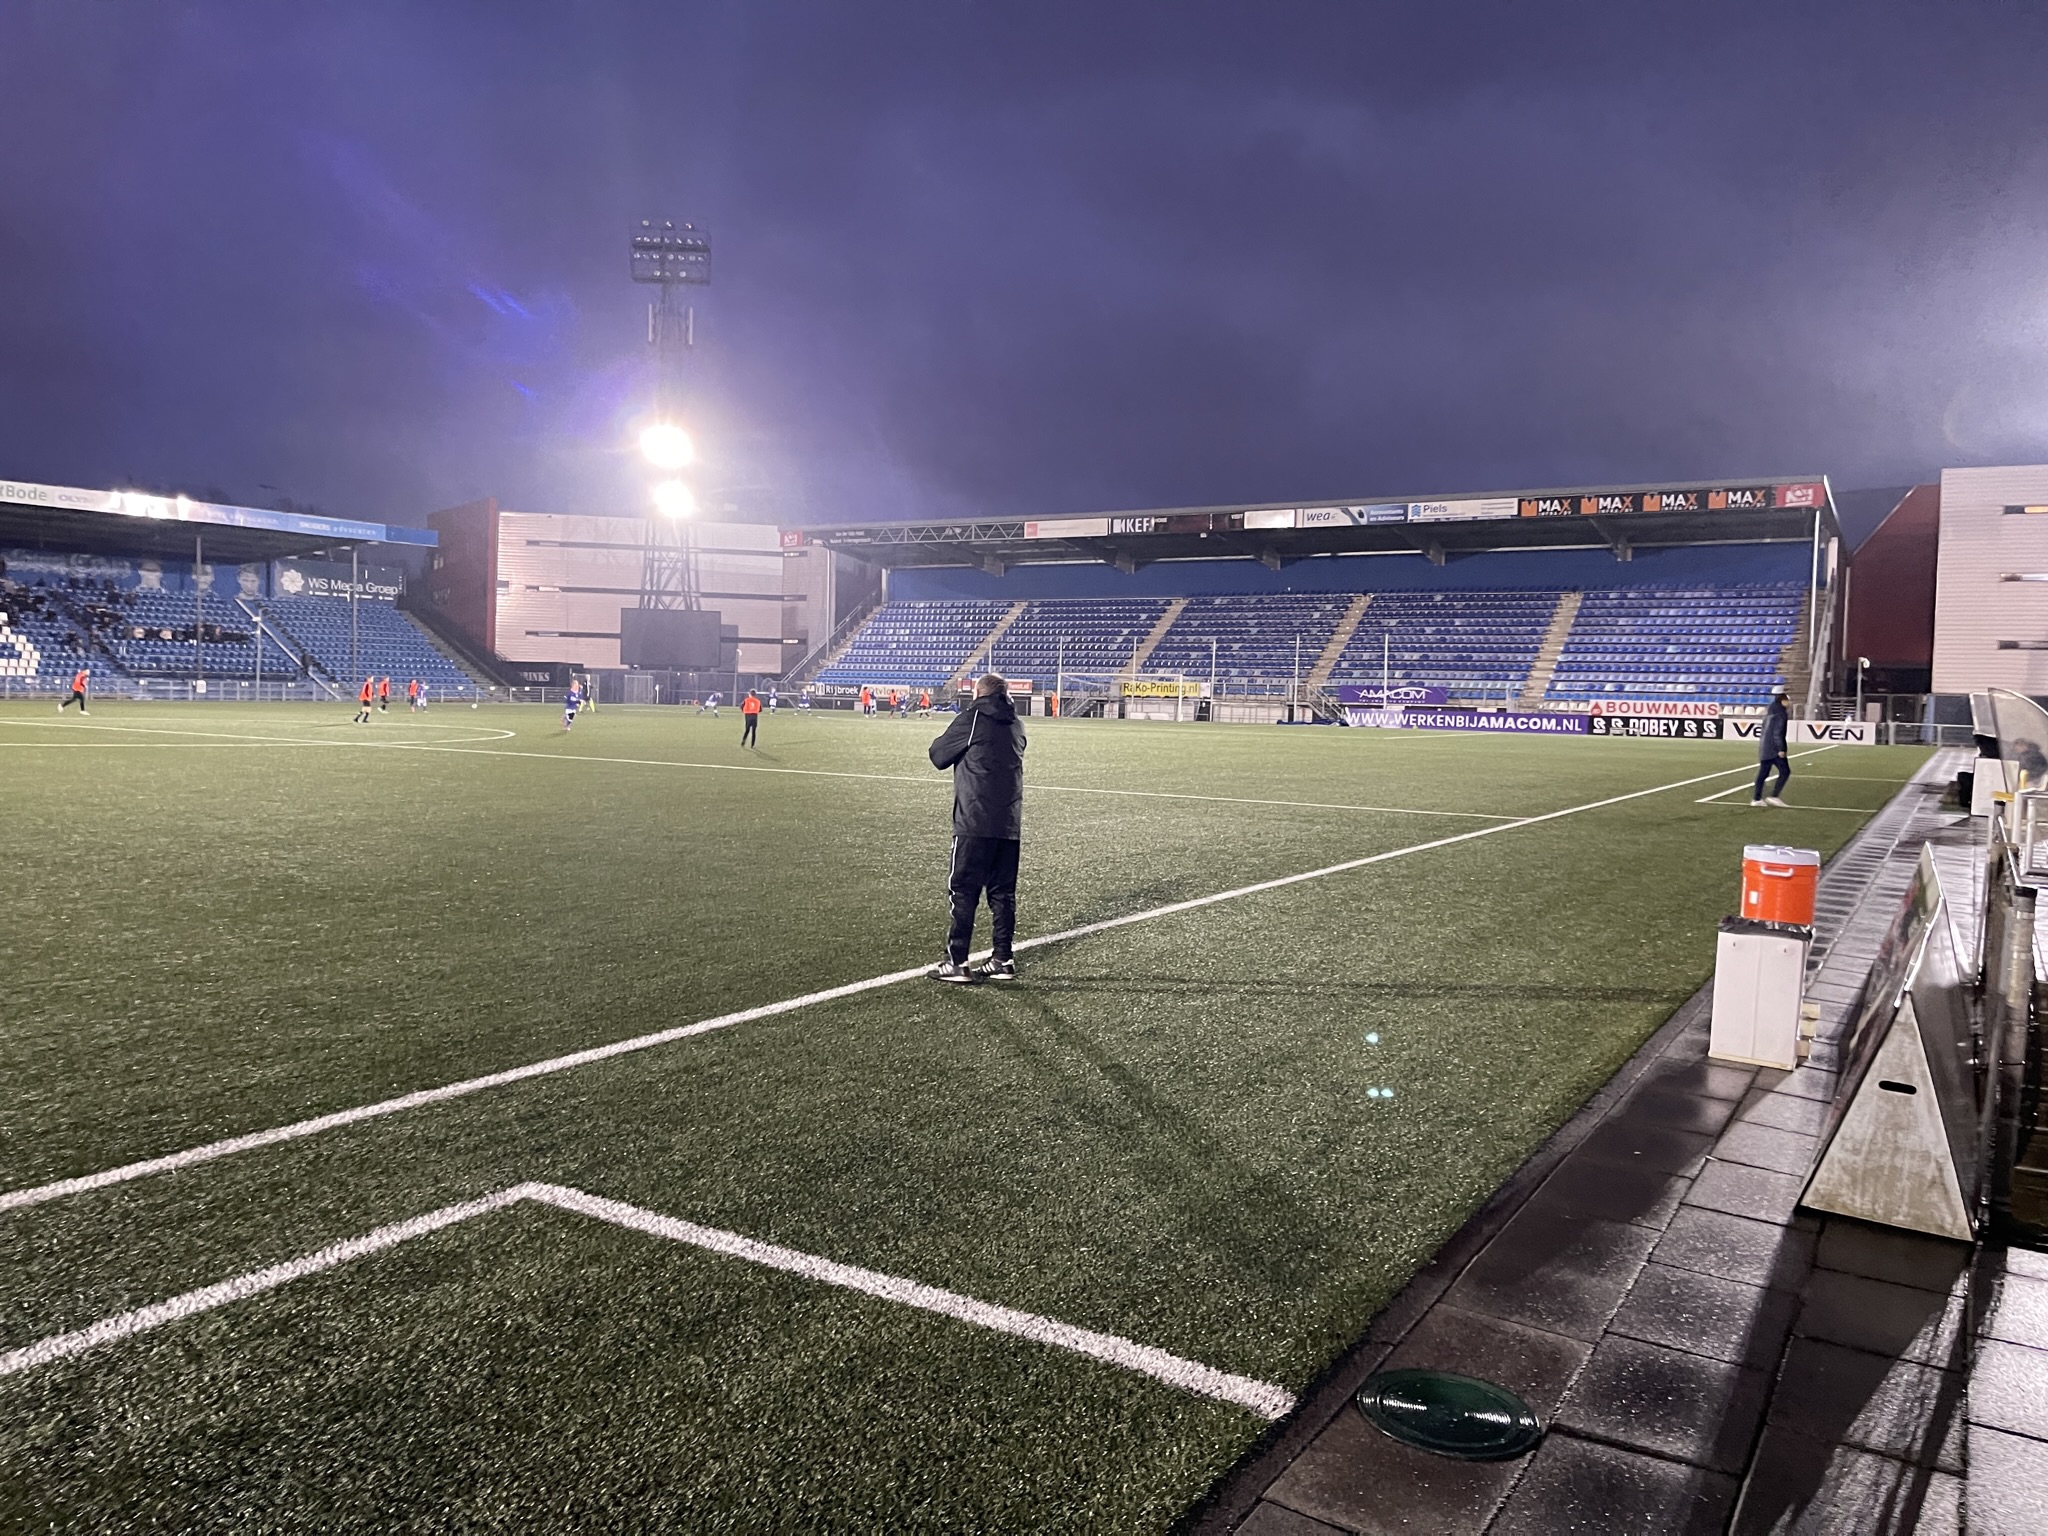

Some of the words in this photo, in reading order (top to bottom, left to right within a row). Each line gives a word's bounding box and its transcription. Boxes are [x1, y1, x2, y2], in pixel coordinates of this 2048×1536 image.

[1539, 498, 1571, 514] MAX
[1599, 496, 1633, 512] MAX
[1662, 493, 1698, 509] MAX
[1728, 490, 1766, 506] MAX
[1423, 504, 1448, 513] Piels
[308, 577, 329, 590] WS
[365, 581, 398, 596] Groep
[825, 685, 859, 696] Rijbroek
[1606, 701, 1719, 716] BOUWMANS
[1347, 711, 1583, 732] WWW.WERKENBIJAMACOM.NL
[1629, 718, 1679, 737] ROBEY
